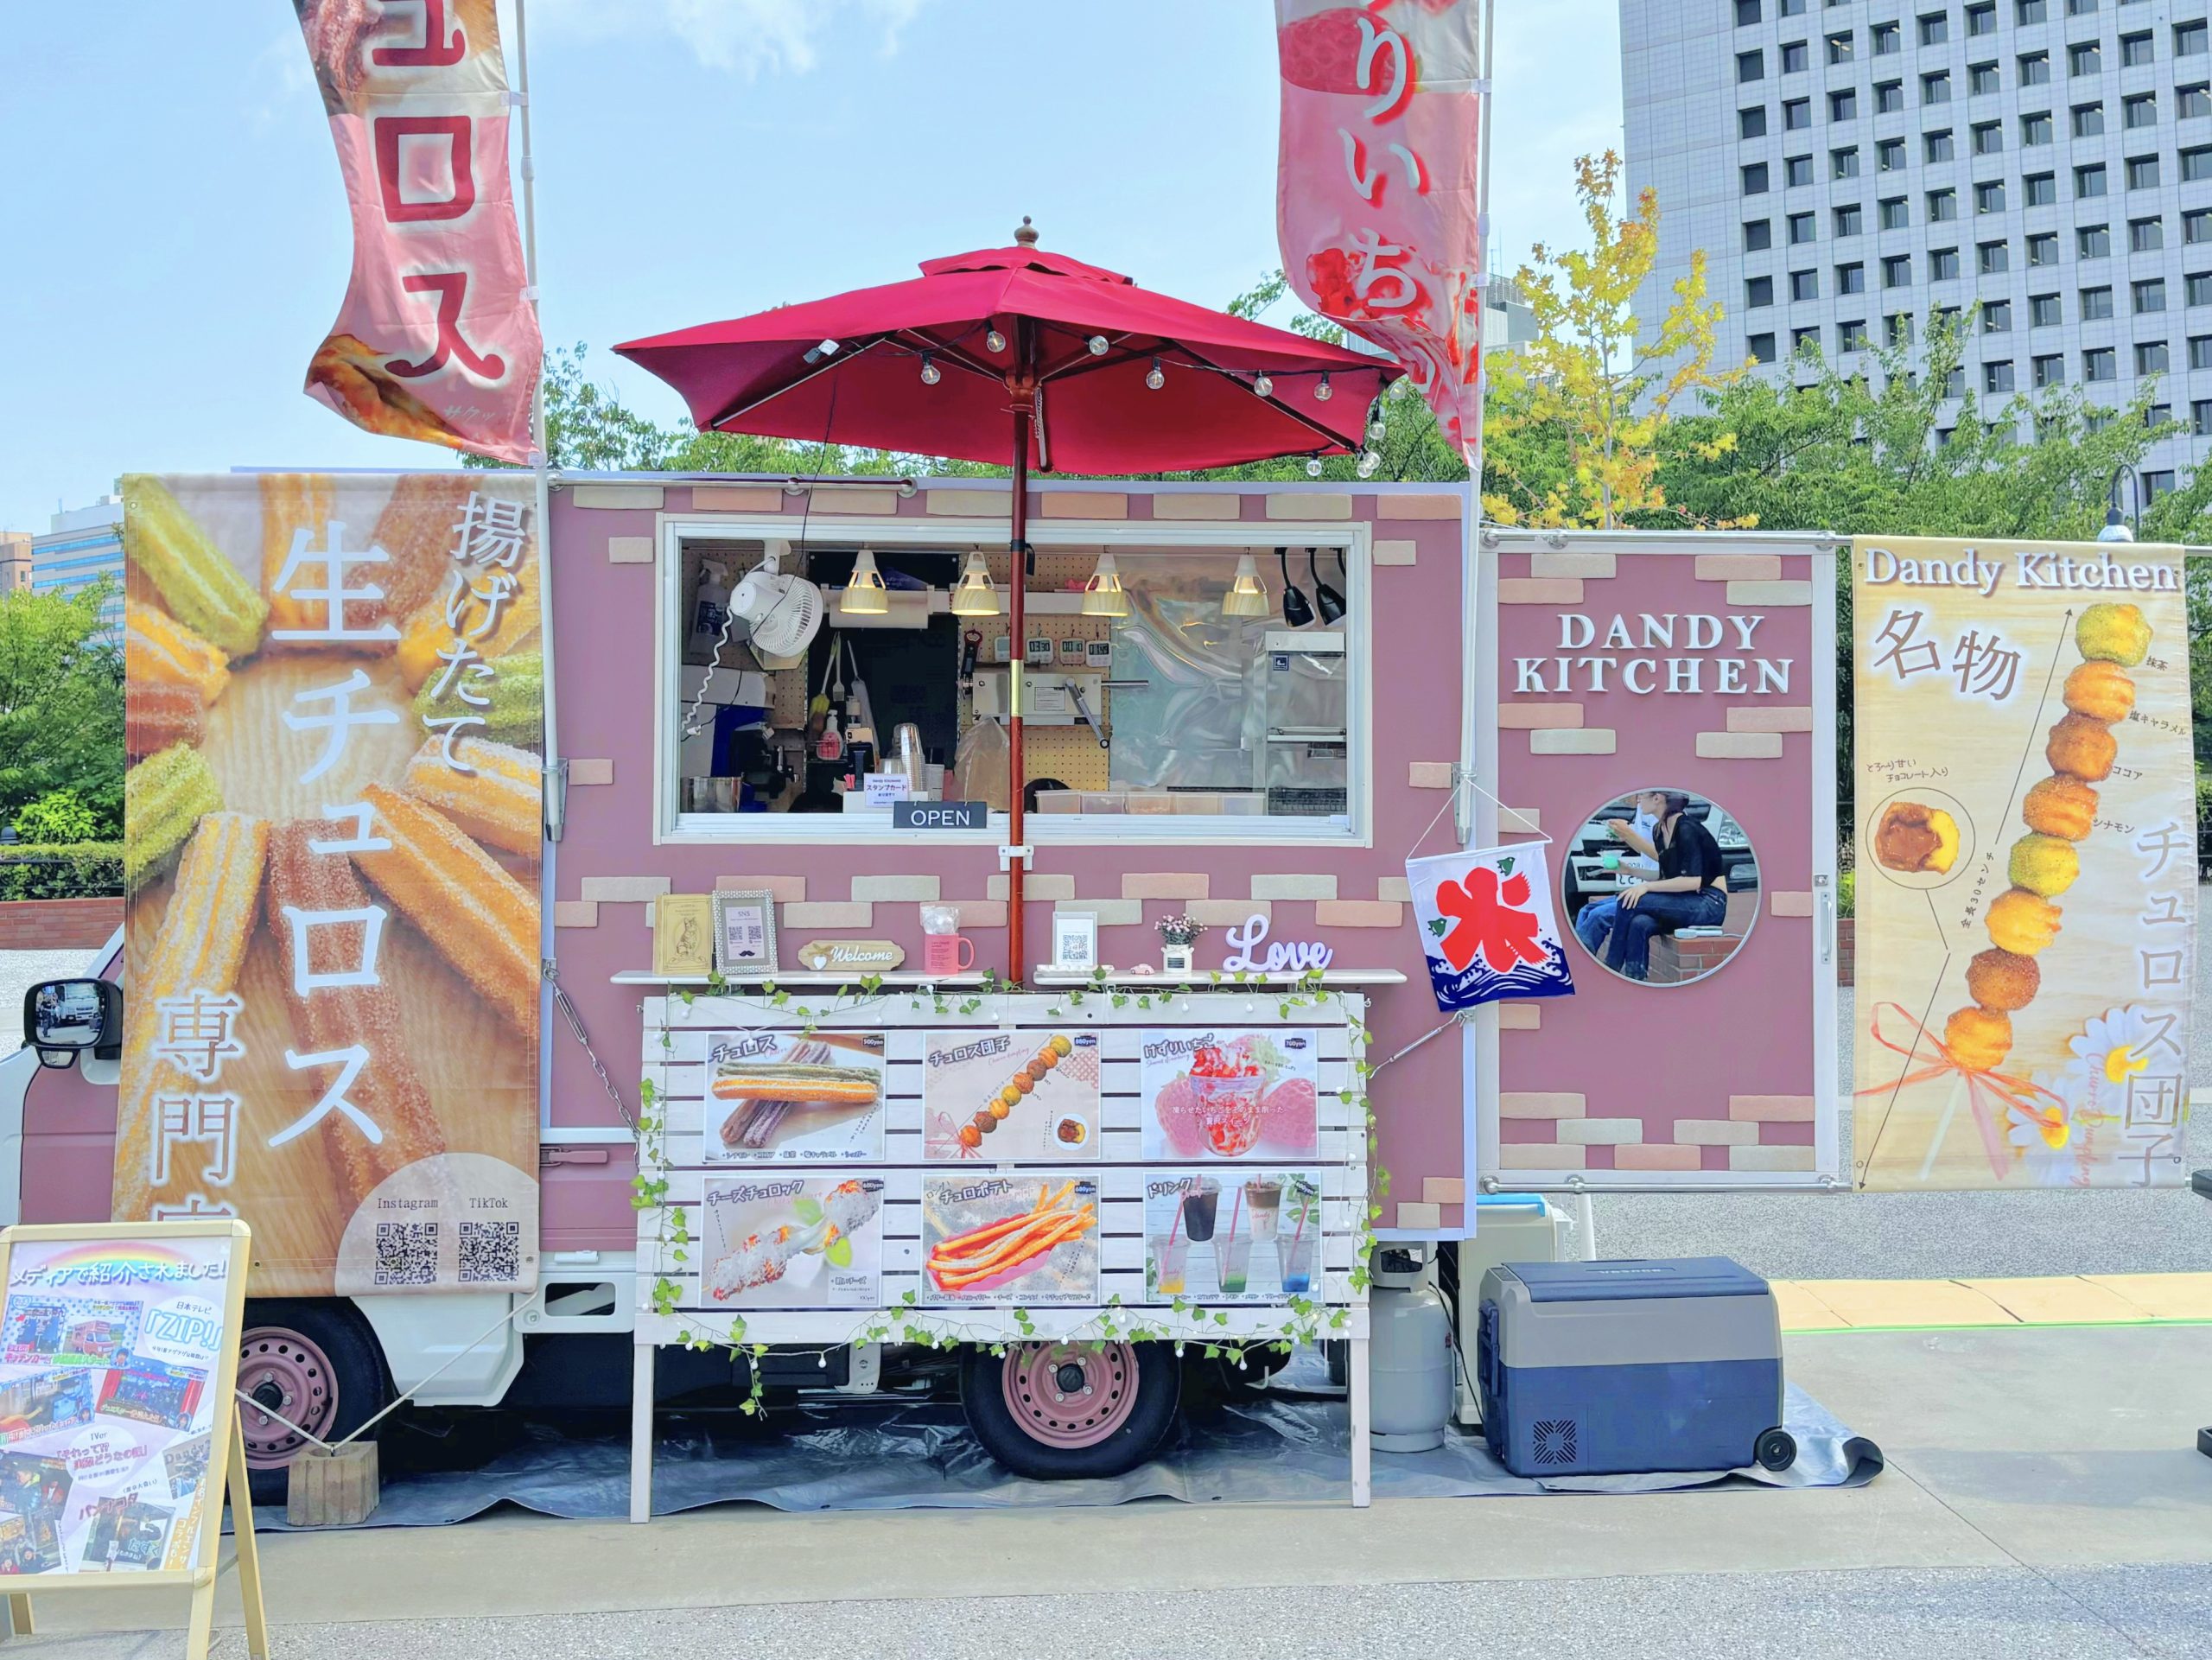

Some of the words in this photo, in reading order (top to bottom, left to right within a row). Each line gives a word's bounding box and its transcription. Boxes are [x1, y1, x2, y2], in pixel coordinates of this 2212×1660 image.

[1864, 547, 2003, 596] Dandy
[2014, 550, 2179, 590] Kitchen
[421, 490, 527, 772] 揚げたて
[1556, 613, 1765, 650] DANDY
[1873, 608, 2022, 701] 名物
[1513, 657, 1795, 694] KITCHEN
[2113, 766, 2143, 780] ココア
[911, 810, 970, 826] OPEN
[2093, 817, 2135, 834] シナモン
[268, 520, 402, 1148] 生チュロス
[830, 946, 893, 964] Welcome
[1223, 913, 1334, 972] Love
[2118, 822, 2190, 1187] チュロス団子
[714, 1034, 777, 1063] チュロス
[928, 1034, 1010, 1067] チュロス団子
[155, 993, 239, 1221] 専門
[707, 1180, 804, 1206] チーズチュロック
[939, 1179, 1014, 1205] チュロポテト
[1147, 1177, 1192, 1199] ドリンク
[377, 1197, 439, 1211] Instagram
[469, 1197, 509, 1209] TikTok
[176, 1301, 212, 1315] 日本テレビ
